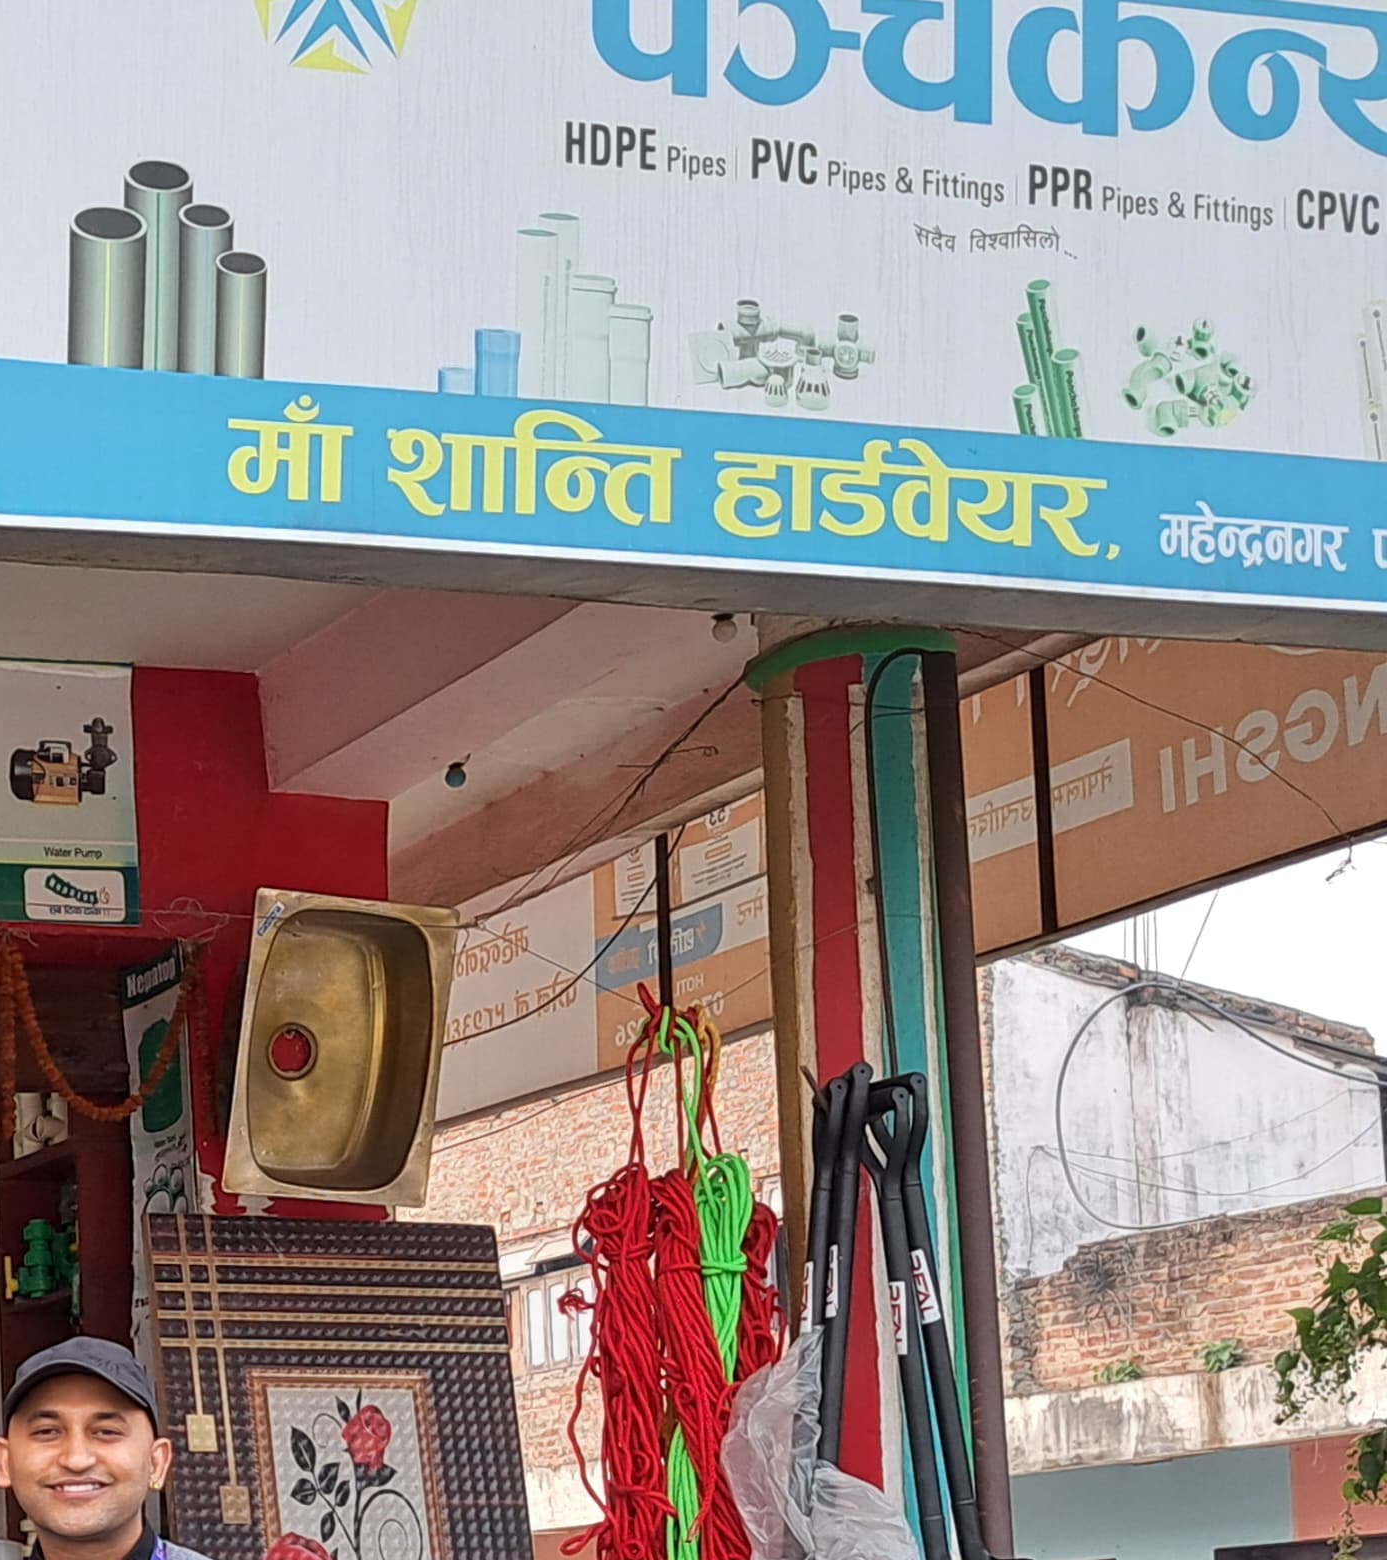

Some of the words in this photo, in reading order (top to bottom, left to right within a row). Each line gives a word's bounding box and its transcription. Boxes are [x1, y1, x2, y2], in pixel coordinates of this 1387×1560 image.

[564, 120, 658, 171] HDPE
[667, 144, 727, 180] Pipes
[750, 138, 819, 187] PVC
[827, 160, 887, 196] Pipes
[895, 167, 915, 195] &
[922, 170, 1005, 207] Fittings
[1028, 164, 1093, 211] PPR
[1101, 185, 1160, 220] Pipes
[1167, 191, 1187, 219] &
[1193, 194, 1275, 228] Fittings
[1295, 188, 1381, 237] CPVC
[228, 394, 353, 502] माँ
[387, 410, 682, 527] शान्ति
[1158, 500, 1350, 572] महेन्द्रनगर
[43, 846, 72, 859] Water
[74, 847, 103, 861] Pump
